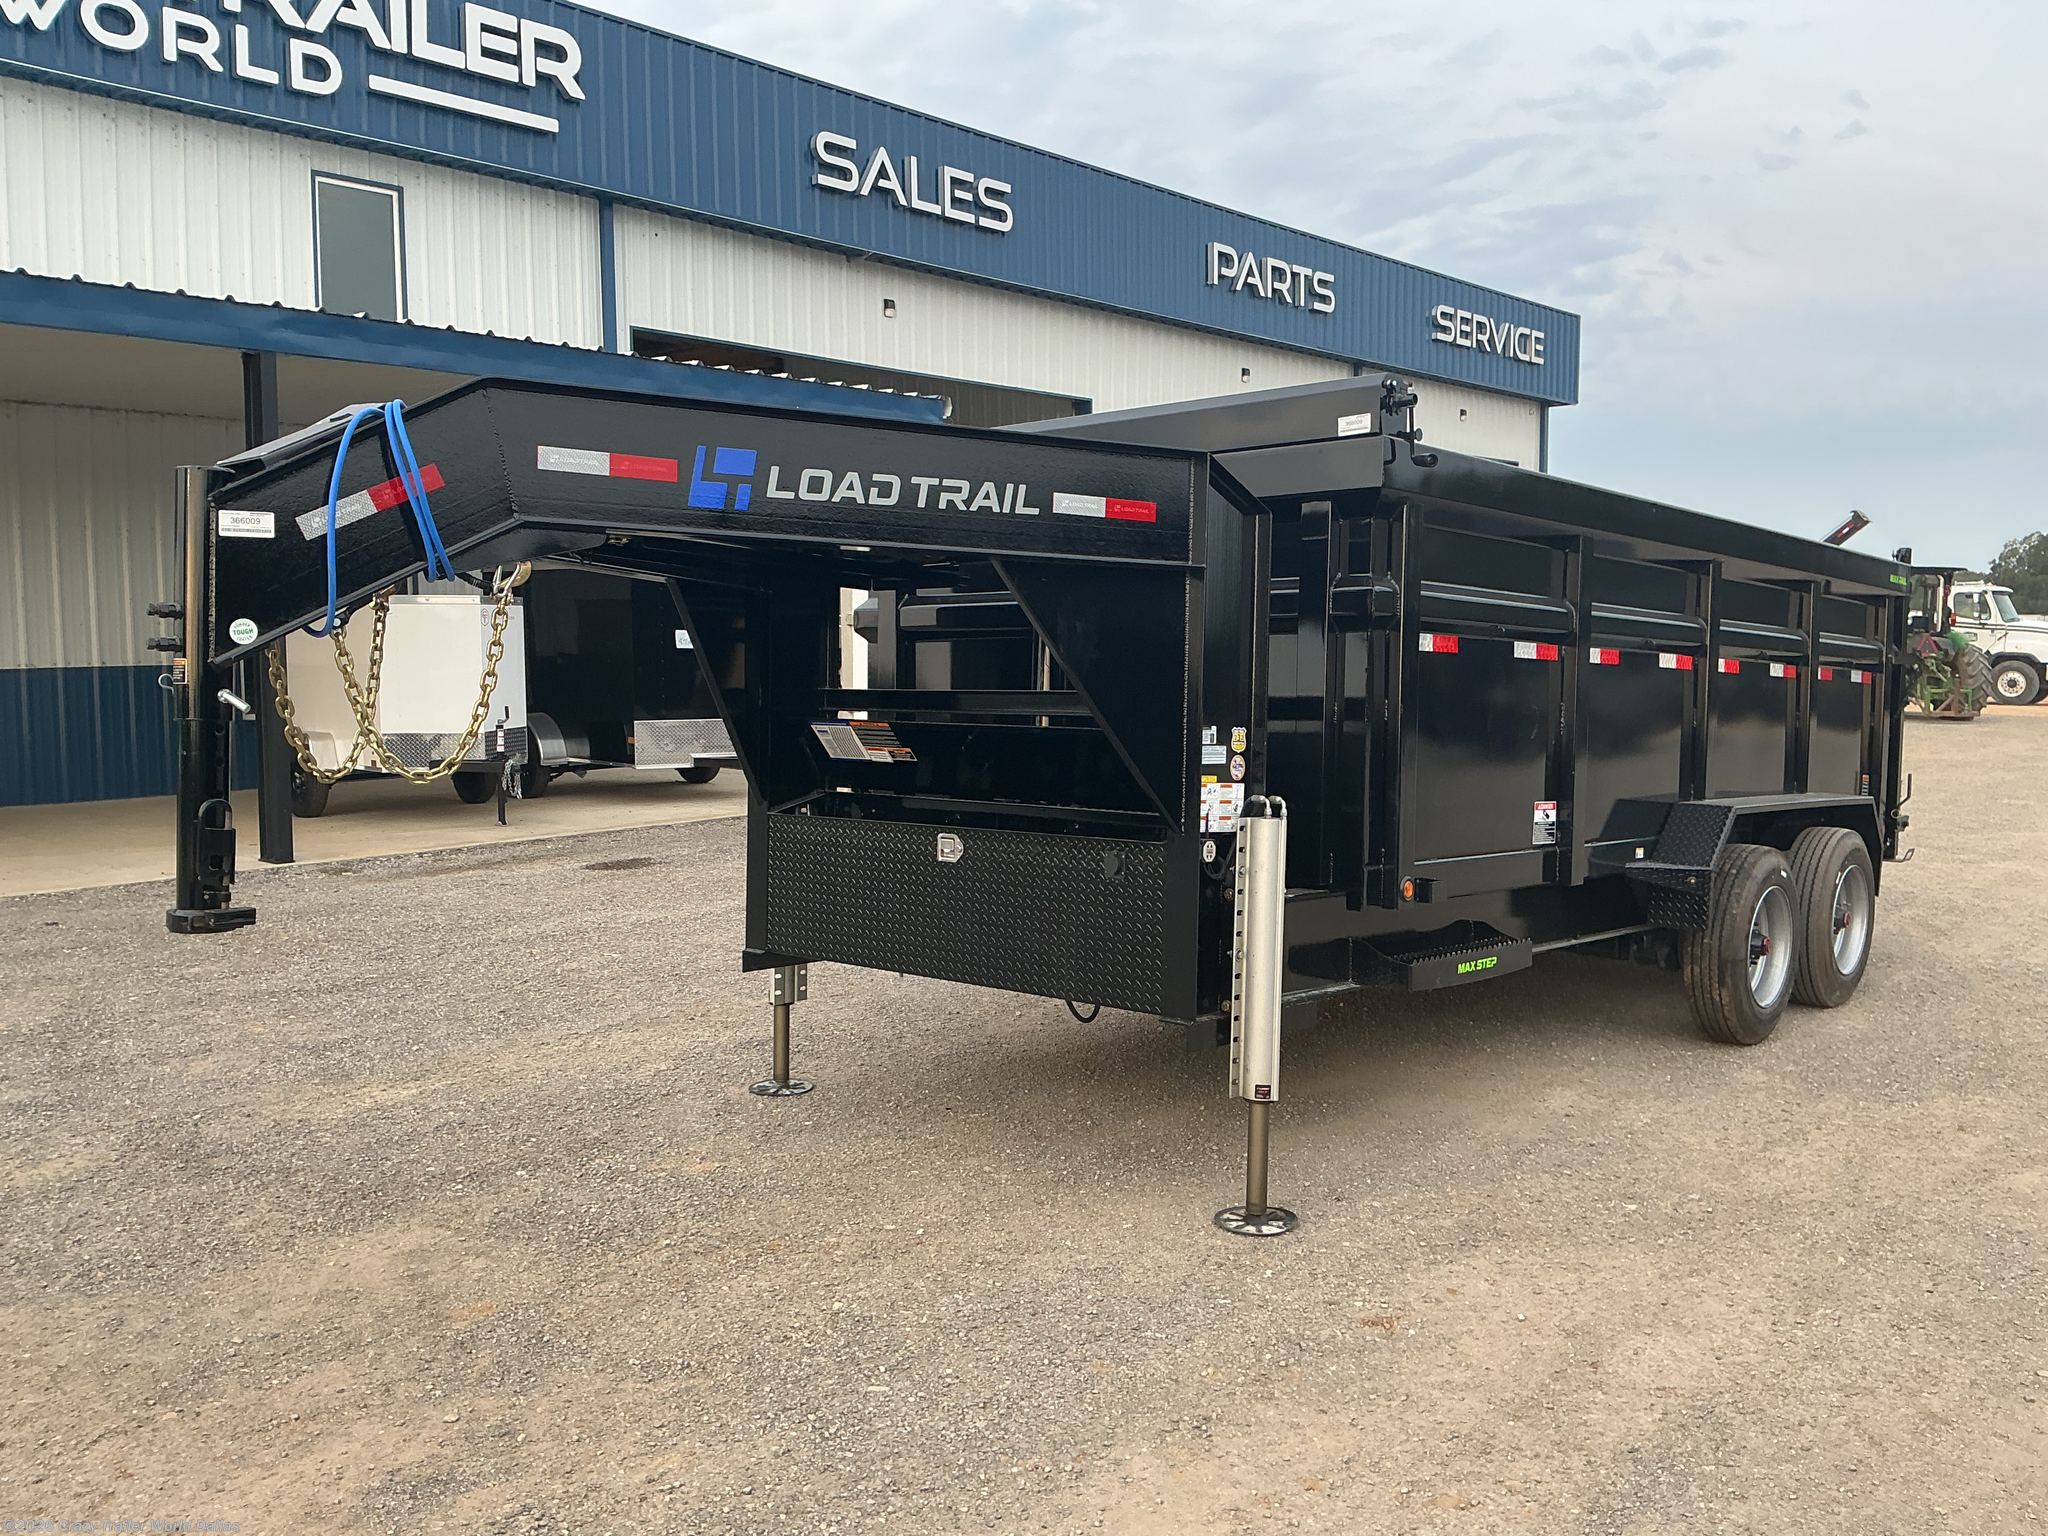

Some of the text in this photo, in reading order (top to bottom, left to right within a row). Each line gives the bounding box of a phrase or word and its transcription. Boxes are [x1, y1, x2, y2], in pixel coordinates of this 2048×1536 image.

[0, 0, 343, 96] WORLD
[811, 131, 1014, 233] SALES
[1208, 242, 1336, 313] PARTS
[1432, 304, 1545, 365] SERVICE
[767, 465, 1040, 515] LOAD TRAIL
[230, 516, 261, 525] 366009
[232, 628, 253, 636] TOUGH
[1457, 956, 1498, 974] MAX STEP
